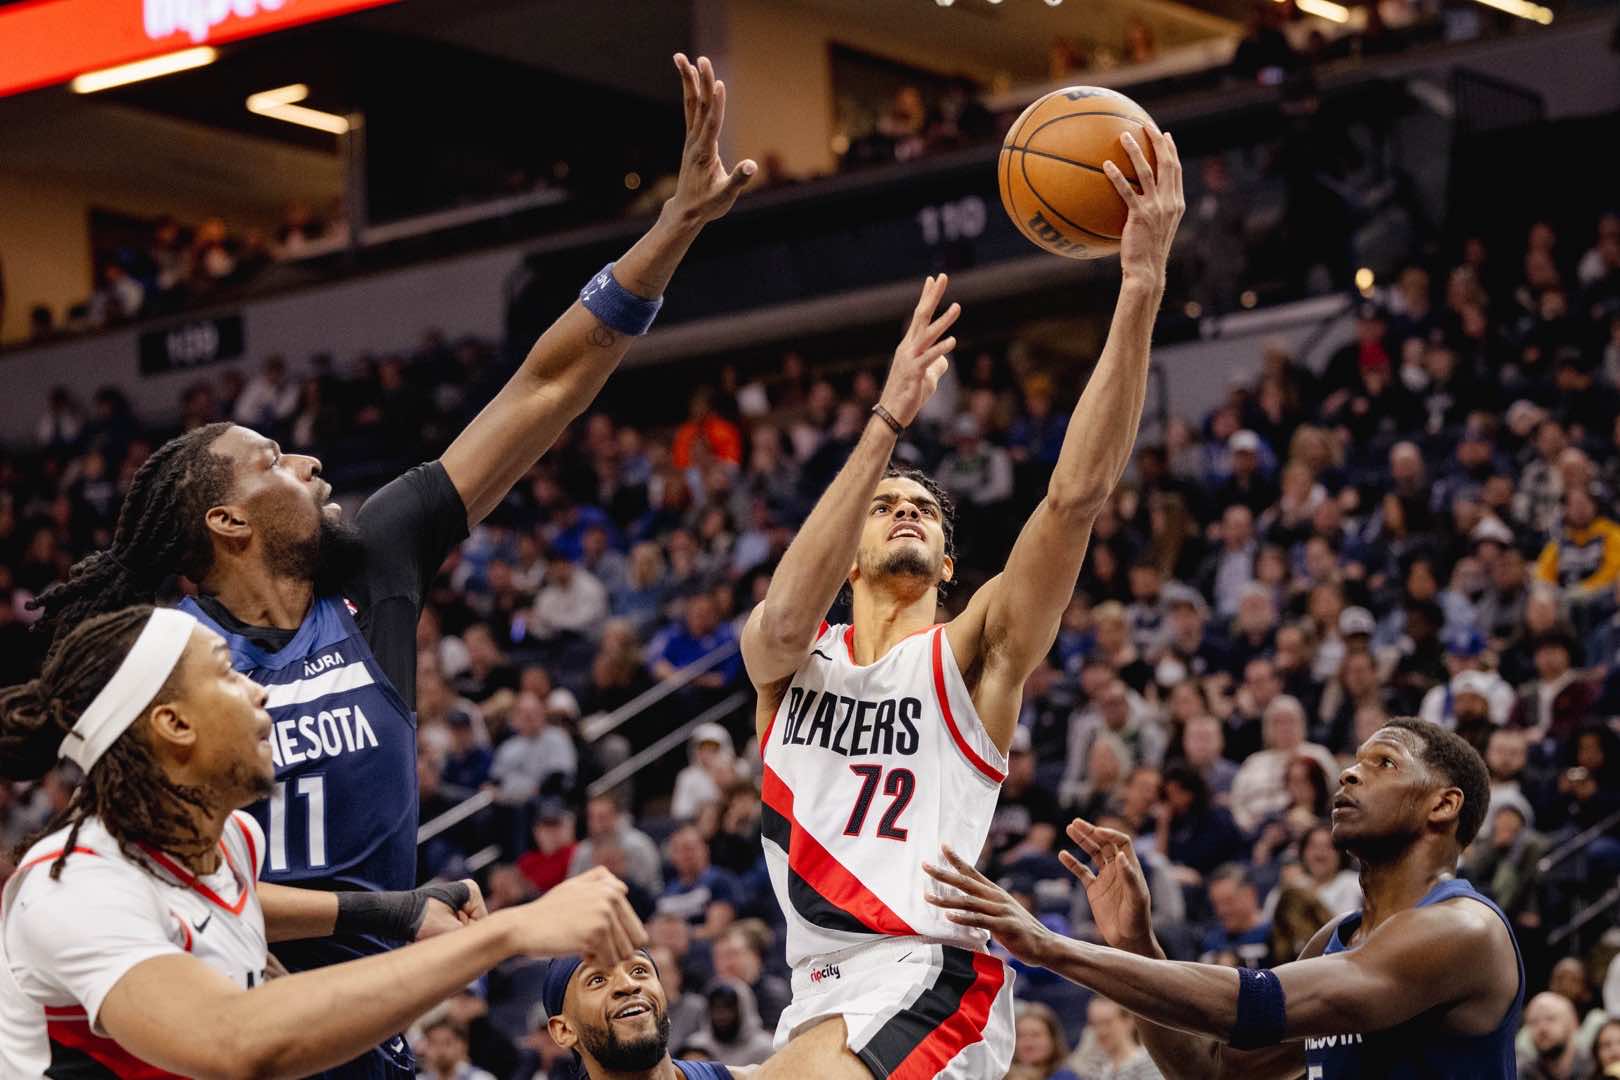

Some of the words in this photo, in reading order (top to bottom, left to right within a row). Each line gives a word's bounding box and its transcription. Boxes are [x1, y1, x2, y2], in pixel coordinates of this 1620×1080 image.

[783, 687, 922, 756] BLAZERS
[270, 776, 326, 870] 11
[843, 764, 915, 842] 72
